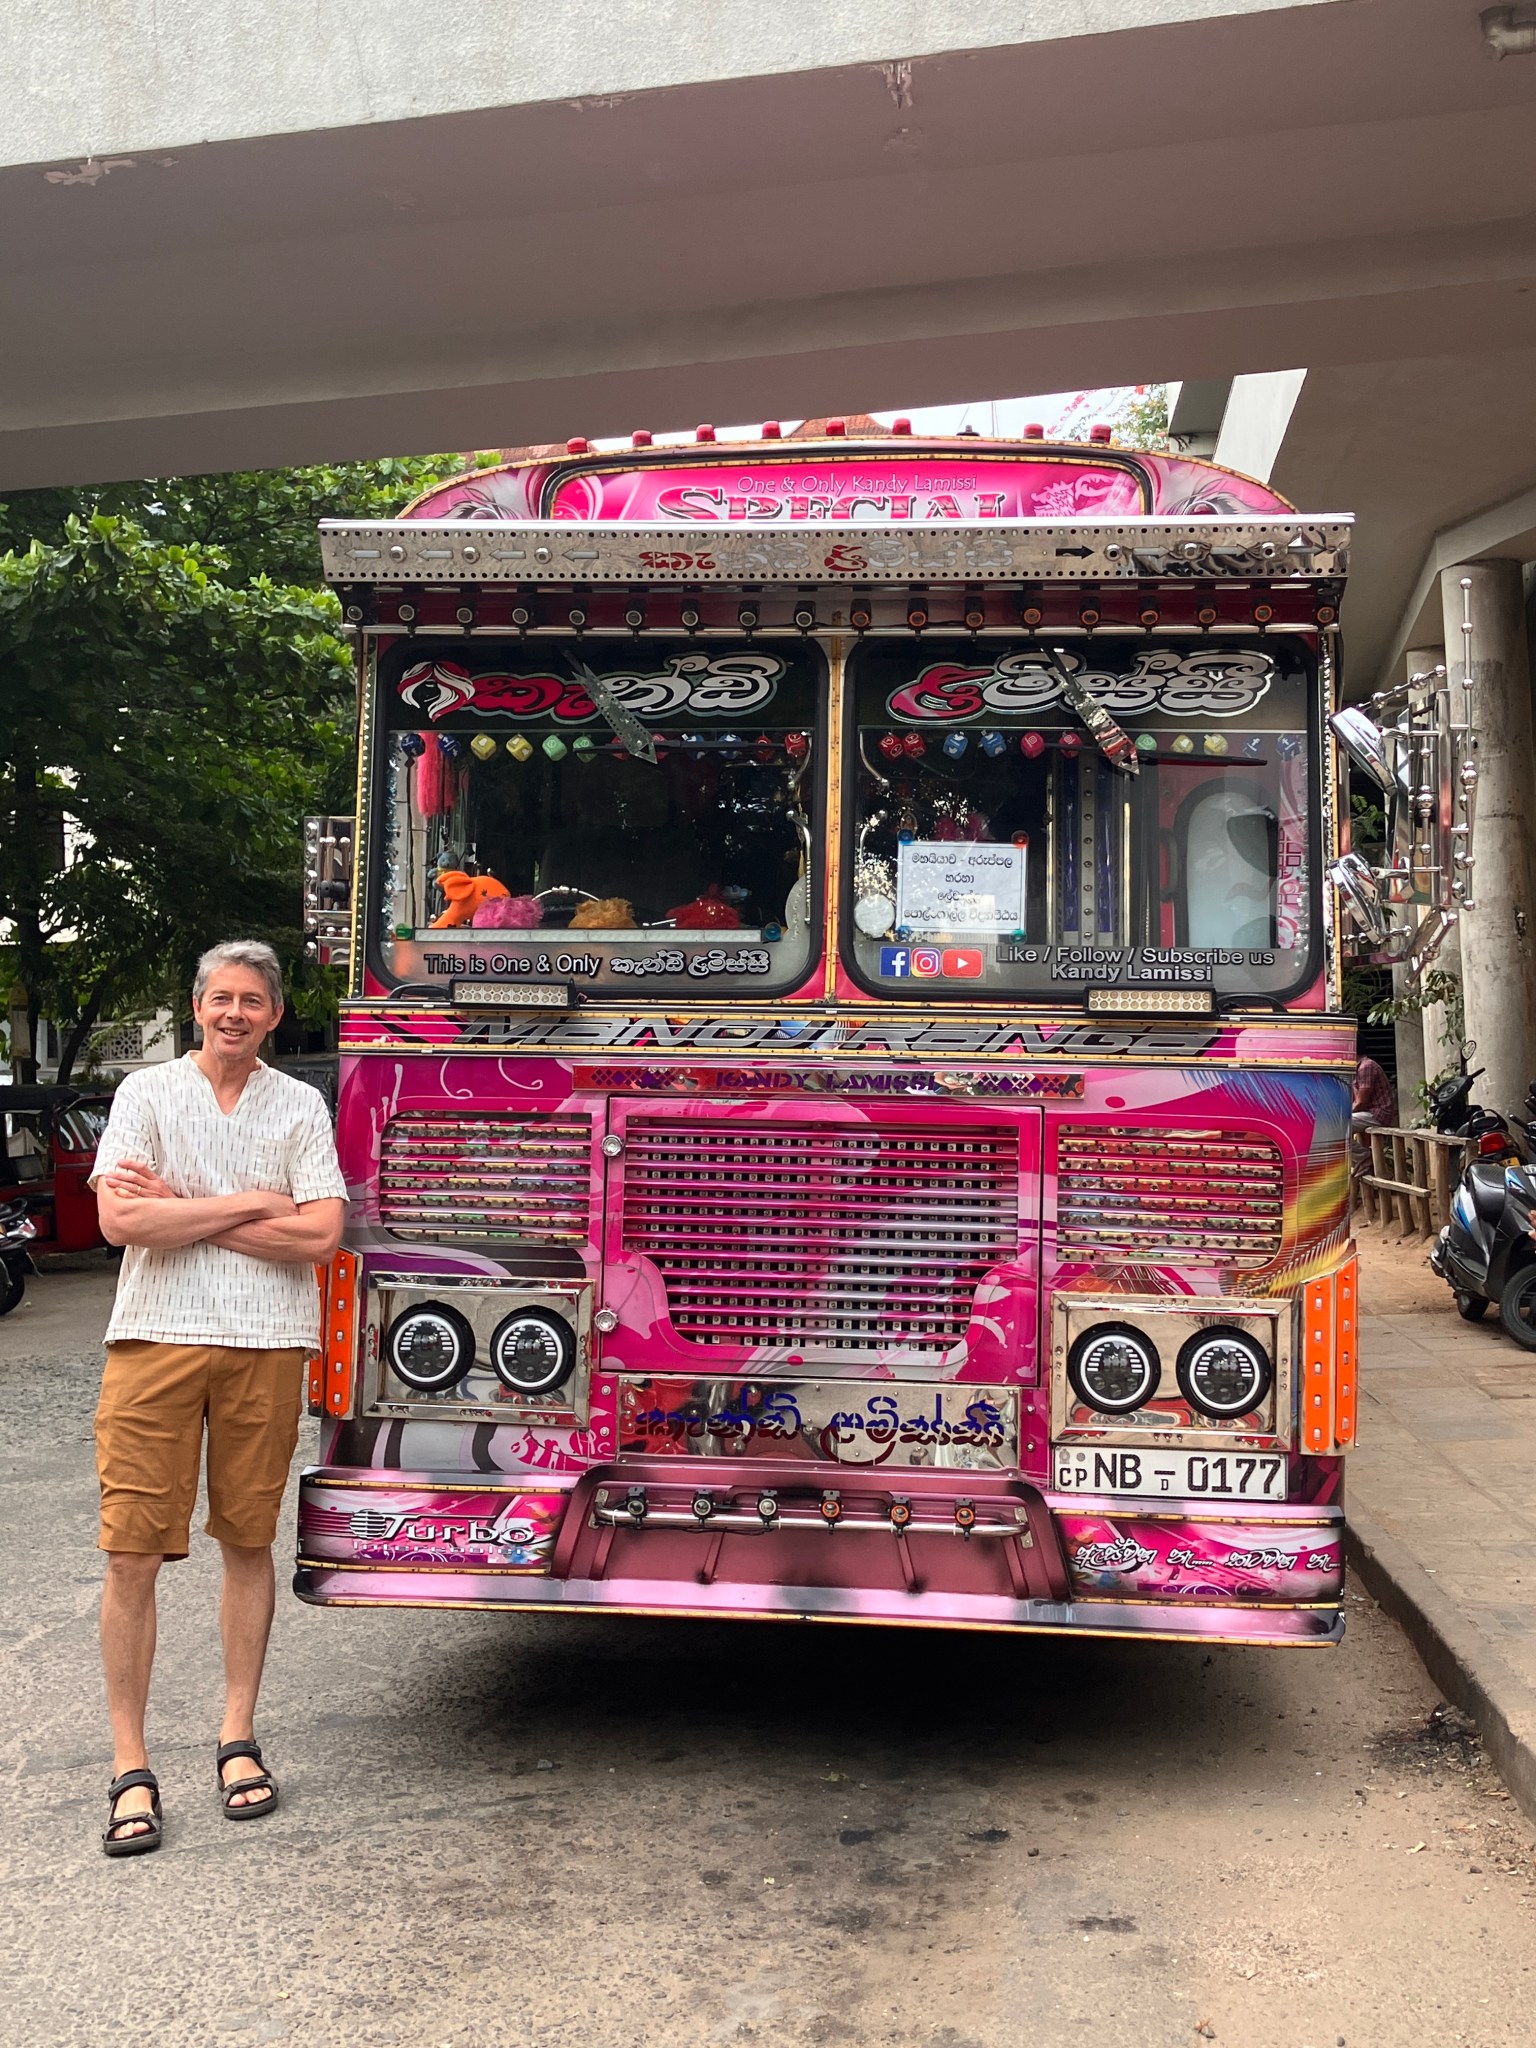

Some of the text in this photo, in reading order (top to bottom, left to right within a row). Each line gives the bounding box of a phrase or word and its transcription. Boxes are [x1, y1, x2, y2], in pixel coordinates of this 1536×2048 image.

[737, 473, 977, 497] One & Only Kandy Lamissi
[425, 954, 465, 973] This
[469, 954, 485, 973] is
[490, 955, 530, 973] One
[536, 955, 553, 973] &
[556, 954, 600, 976] Only
[996, 947, 1038, 964] Like
[1056, 947, 1122, 964] Follow
[1141, 948, 1245, 966] Subscribe
[1249, 952, 1275, 967] us
[1051, 964, 1213, 983] Kandy Lamissi
[716, 1071, 936, 1091] KANDY LAMISSI
[1059, 1467, 1088, 1488] CP
[1094, 1452, 1143, 1489] NB
[1187, 1456, 1282, 1494] 0177
[381, 1513, 538, 1545] Turbo
